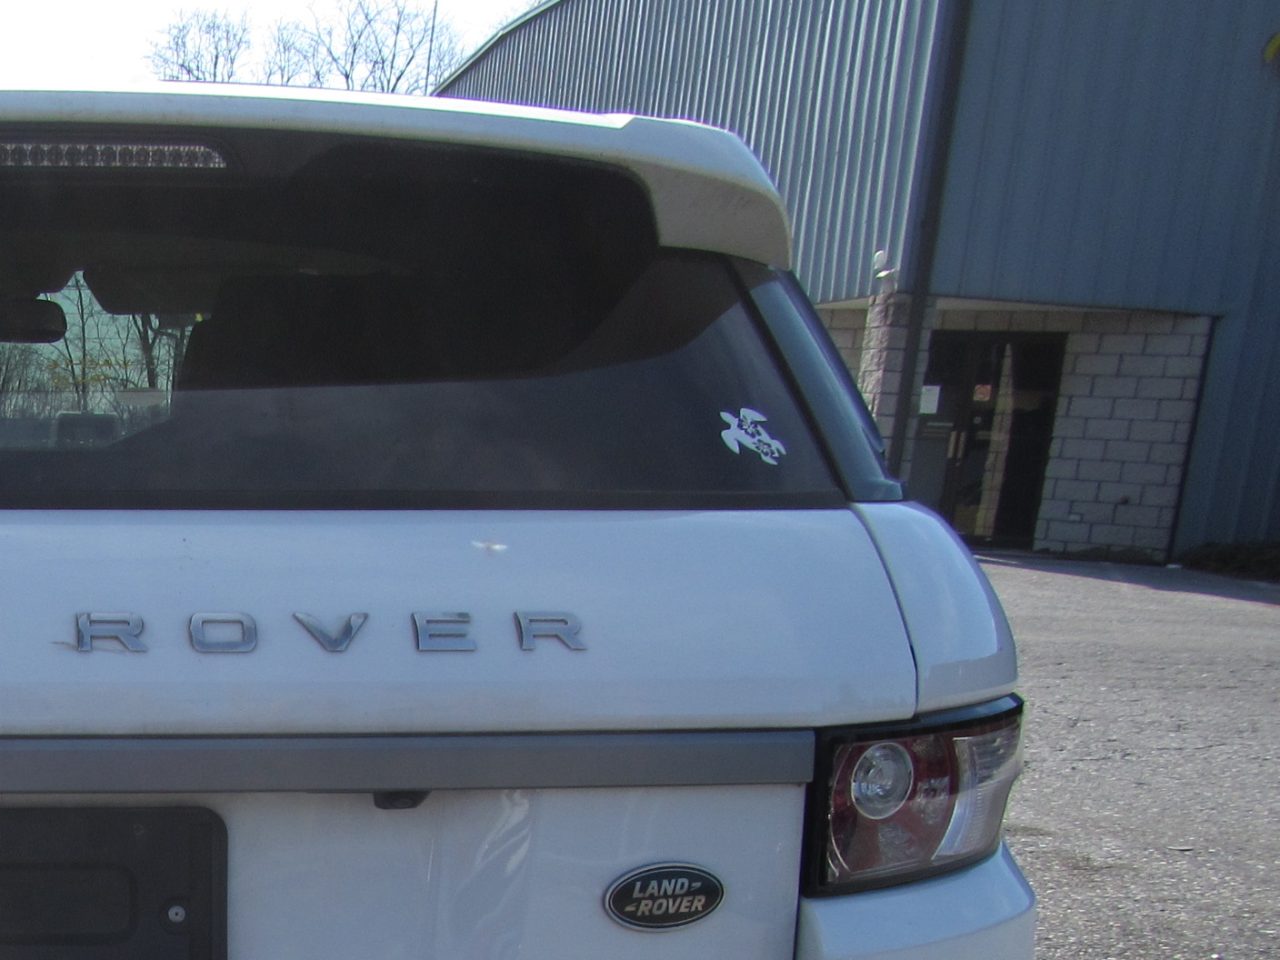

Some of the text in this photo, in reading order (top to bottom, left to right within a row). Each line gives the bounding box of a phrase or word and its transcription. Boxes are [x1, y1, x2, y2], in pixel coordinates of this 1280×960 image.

[75, 612, 588, 652] ROVER
[632, 877, 690, 899] LAND
[635, 895, 706, 917] ROVER
